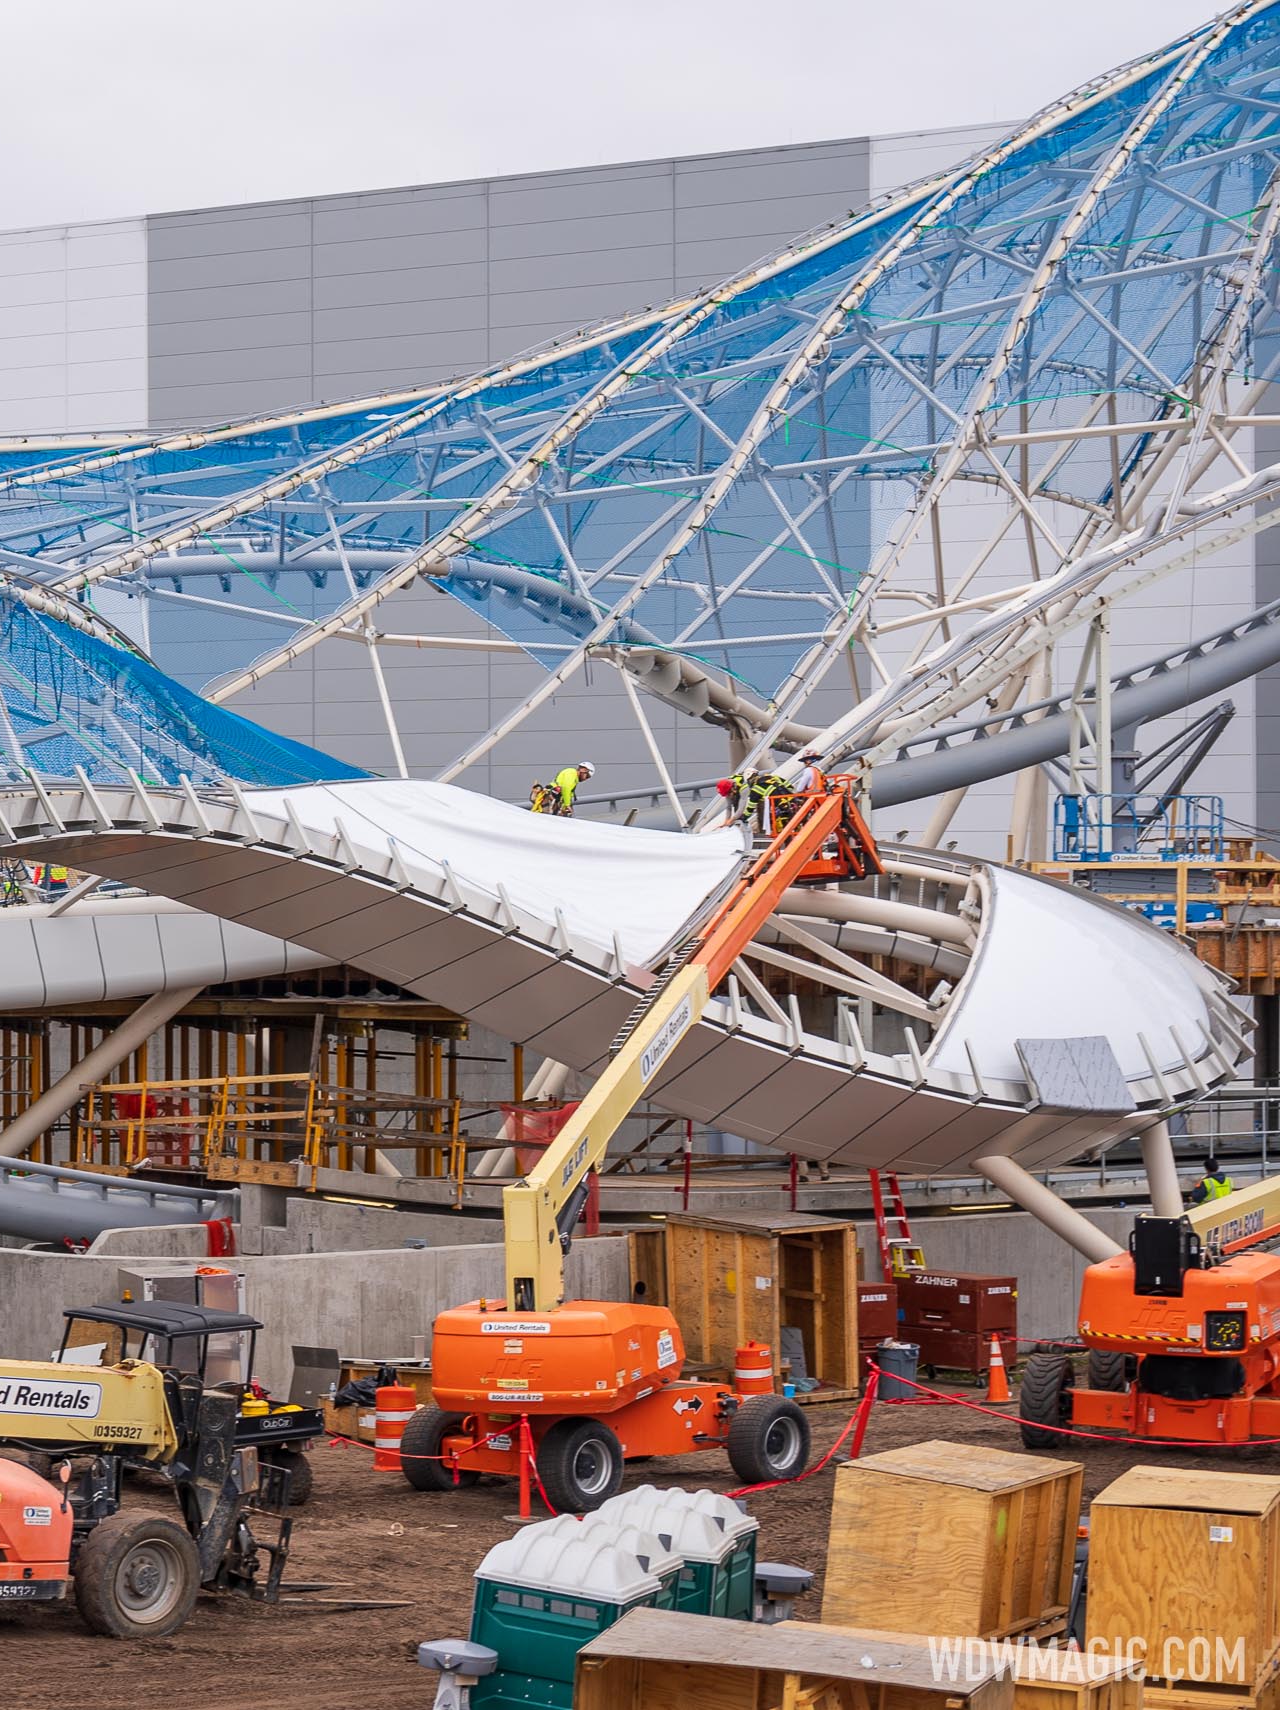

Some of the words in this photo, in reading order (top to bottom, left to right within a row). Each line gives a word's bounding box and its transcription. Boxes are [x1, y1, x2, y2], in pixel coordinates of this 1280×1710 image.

[575, 1135, 588, 1168] LIFT
[915, 1275, 959, 1287] ZAHNER
[14, 1385, 91, 1410] Rentals
[94, 1425, 143, 1440] 10359327
